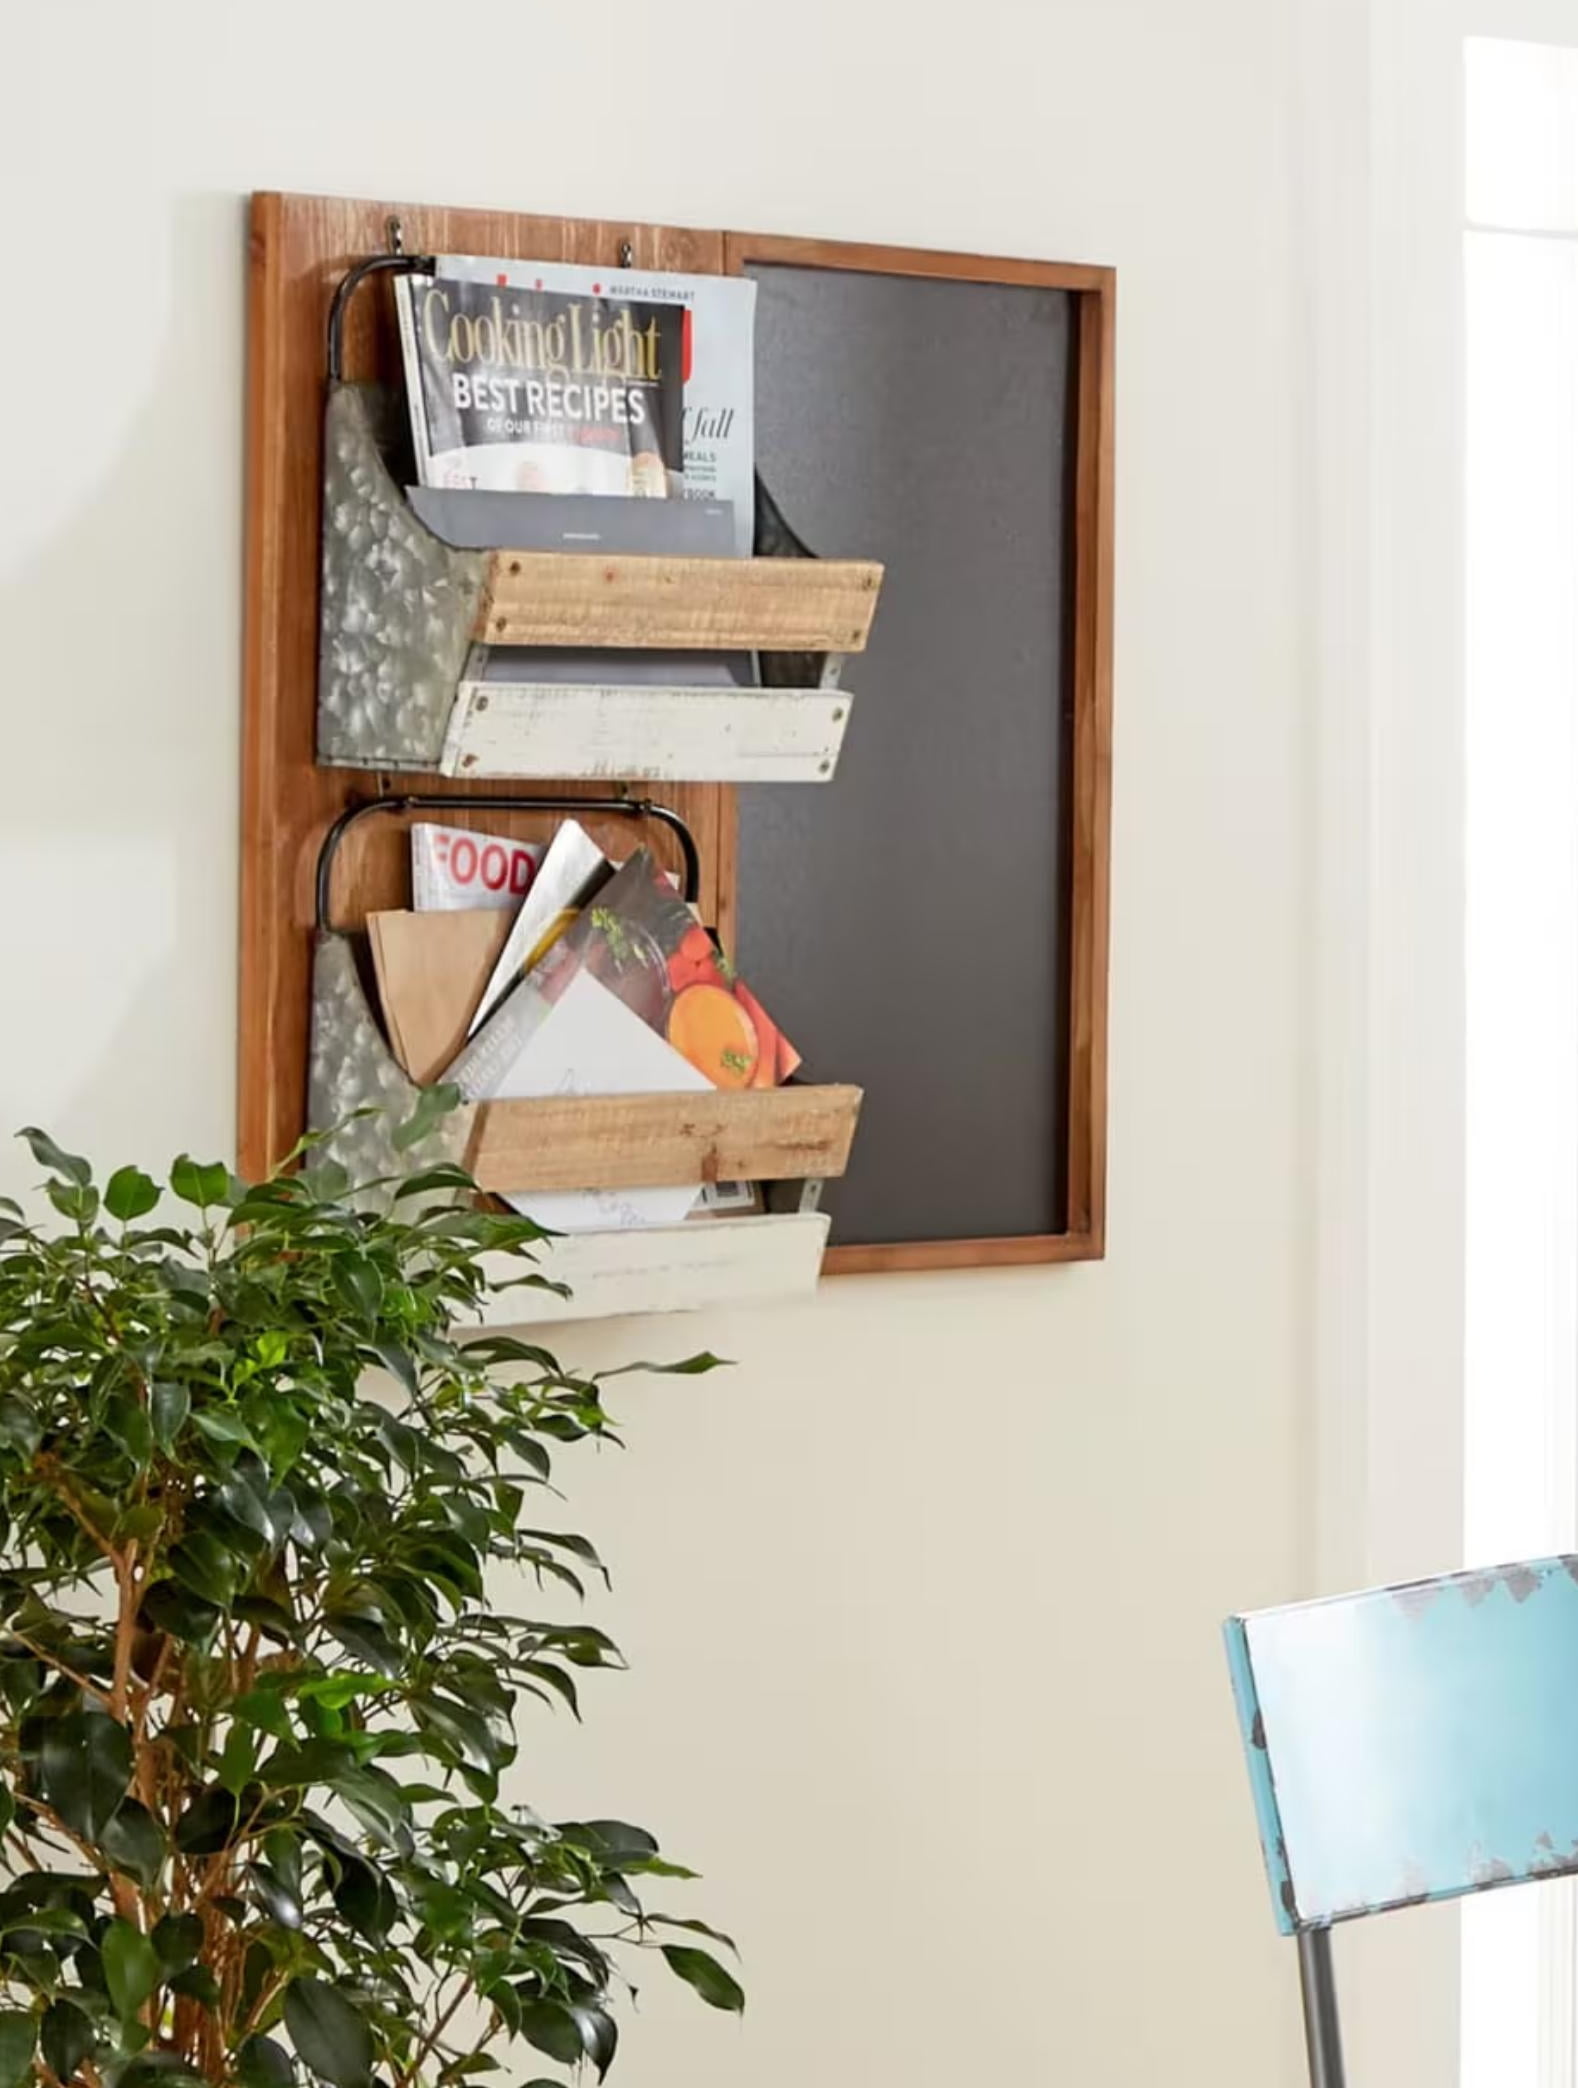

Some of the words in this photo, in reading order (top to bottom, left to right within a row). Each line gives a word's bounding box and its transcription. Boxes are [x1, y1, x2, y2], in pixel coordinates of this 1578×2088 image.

[609, 284, 649, 297] MARTHA
[651, 288, 696, 301] STEWART
[423, 288, 571, 387] Cooking
[567, 301, 662, 388] Light
[452, 372, 519, 414] BEST
[525, 380, 646, 425] RECIPES
[504, 419, 531, 434] OUR
[692, 407, 734, 442] fall
[433, 833, 537, 897] FOOD
